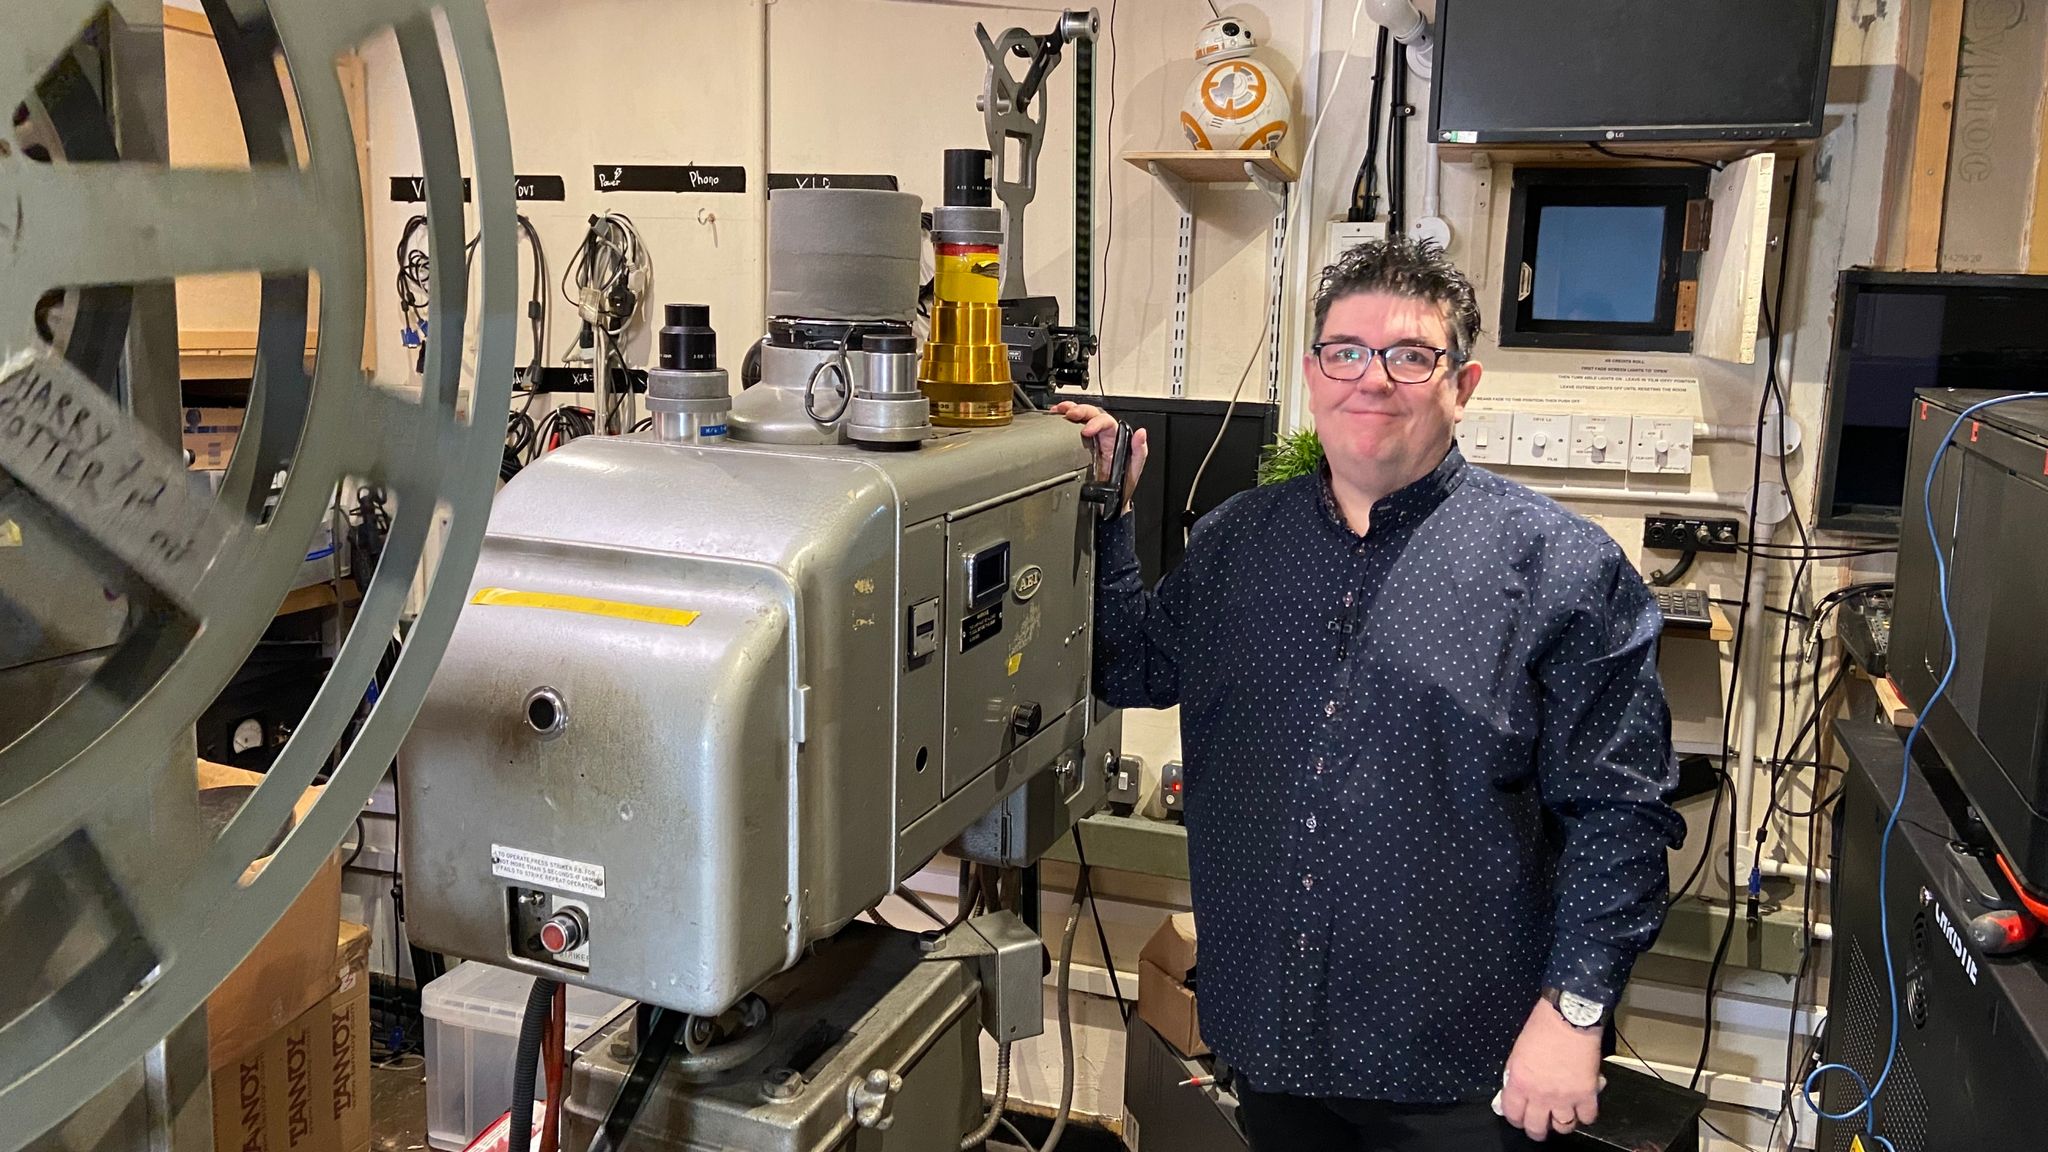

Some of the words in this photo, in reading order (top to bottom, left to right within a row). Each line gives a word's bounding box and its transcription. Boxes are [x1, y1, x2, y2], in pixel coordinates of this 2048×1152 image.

[598, 173, 620, 188] Power
[688, 170, 719, 188] Phono
[510, 860, 526, 869] MORE
[547, 868, 573, 878] SECONDS
[530, 858, 548, 867] PRESS
[550, 862, 573, 872] STRIKER
[524, 870, 544, 880] STRIKE
[544, 874, 566, 884] REPEAT
[240, 1056, 262, 1152] ANNOY
